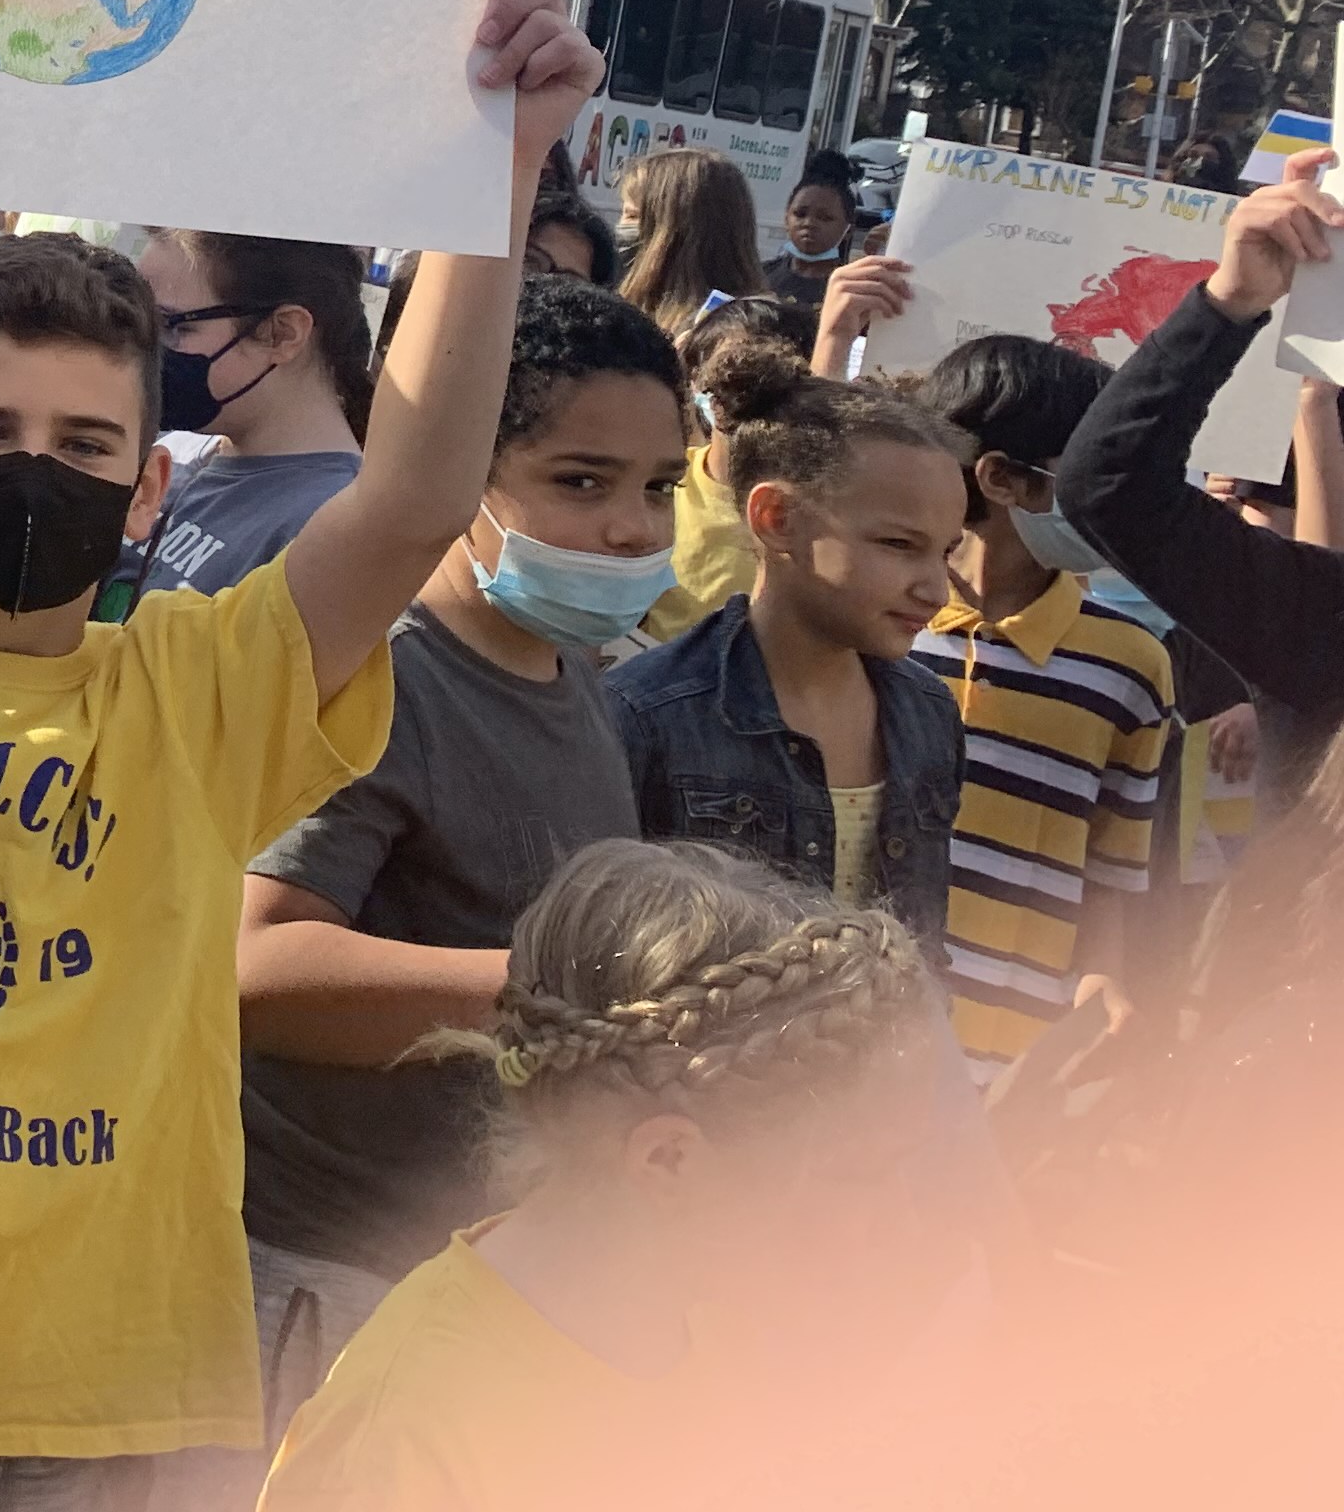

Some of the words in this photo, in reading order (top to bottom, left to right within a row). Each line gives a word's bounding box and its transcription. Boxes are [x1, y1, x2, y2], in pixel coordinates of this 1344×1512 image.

[925, 146, 1096, 198] UKRAINE
[1104, 176, 1149, 209] IS
[1160, 187, 1218, 223] NOT
[984, 222, 1021, 240] STOP
[39, 928, 93, 983] 19
